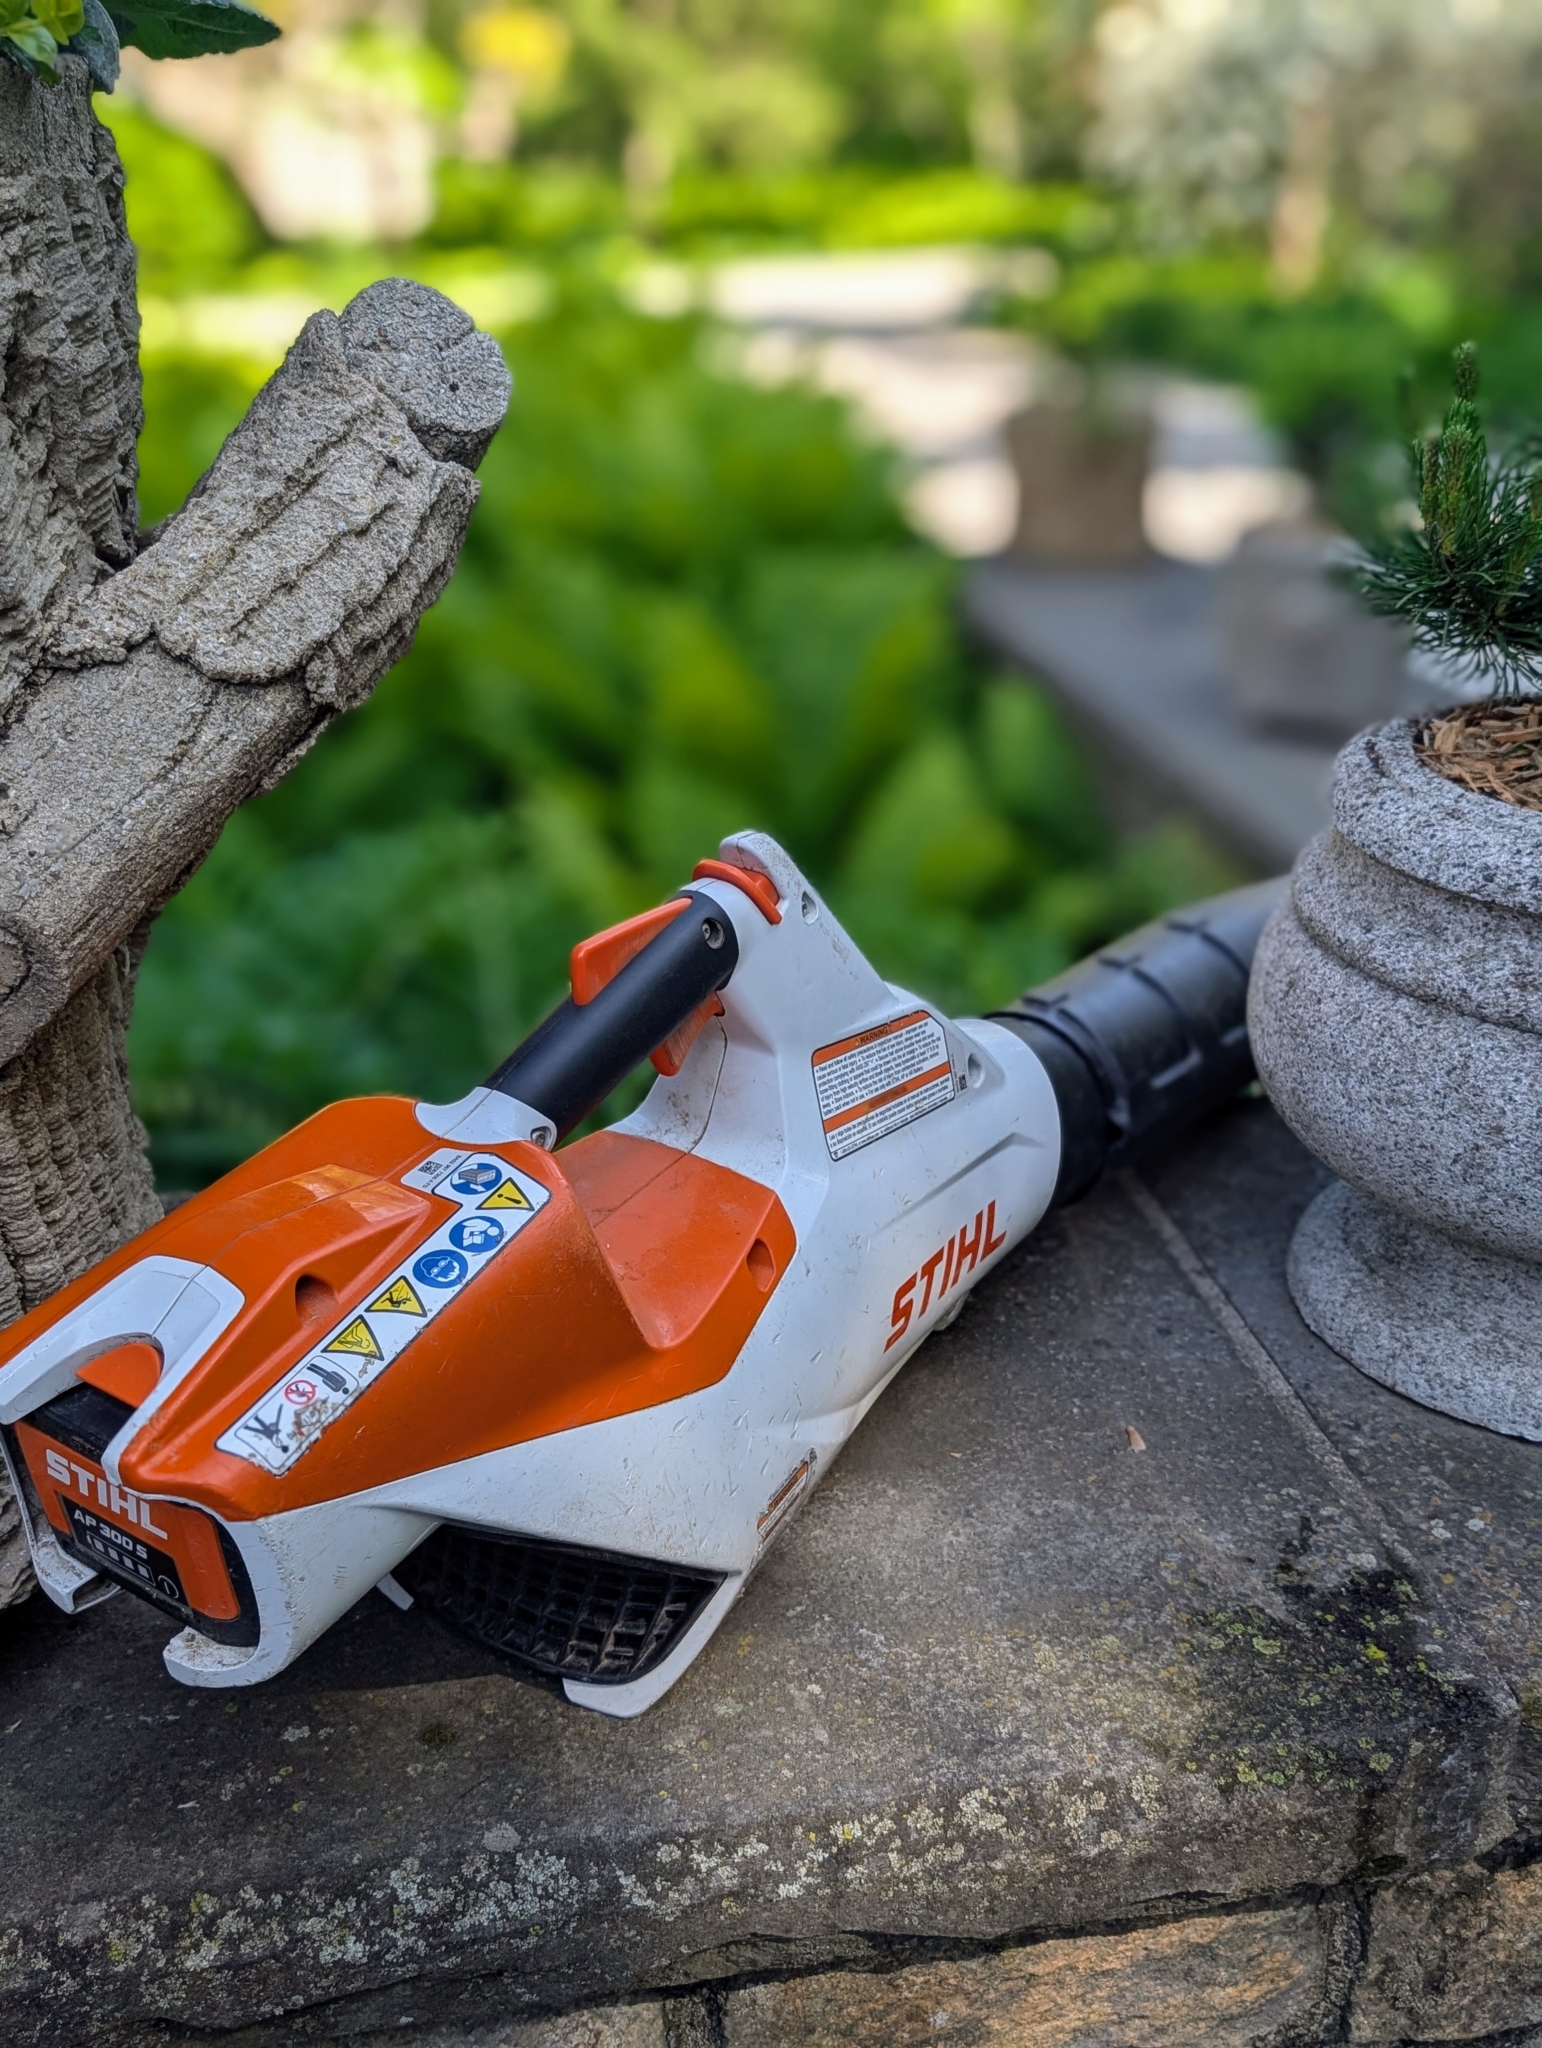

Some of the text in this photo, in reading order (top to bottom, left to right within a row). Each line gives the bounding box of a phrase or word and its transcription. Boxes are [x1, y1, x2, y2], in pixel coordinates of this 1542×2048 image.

[859, 1025, 888, 1044] WARNING
[883, 1199, 1007, 1354] STIHL
[45, 1448, 168, 1541] STIHL
[73, 1509, 147, 1560] AP 300 S
